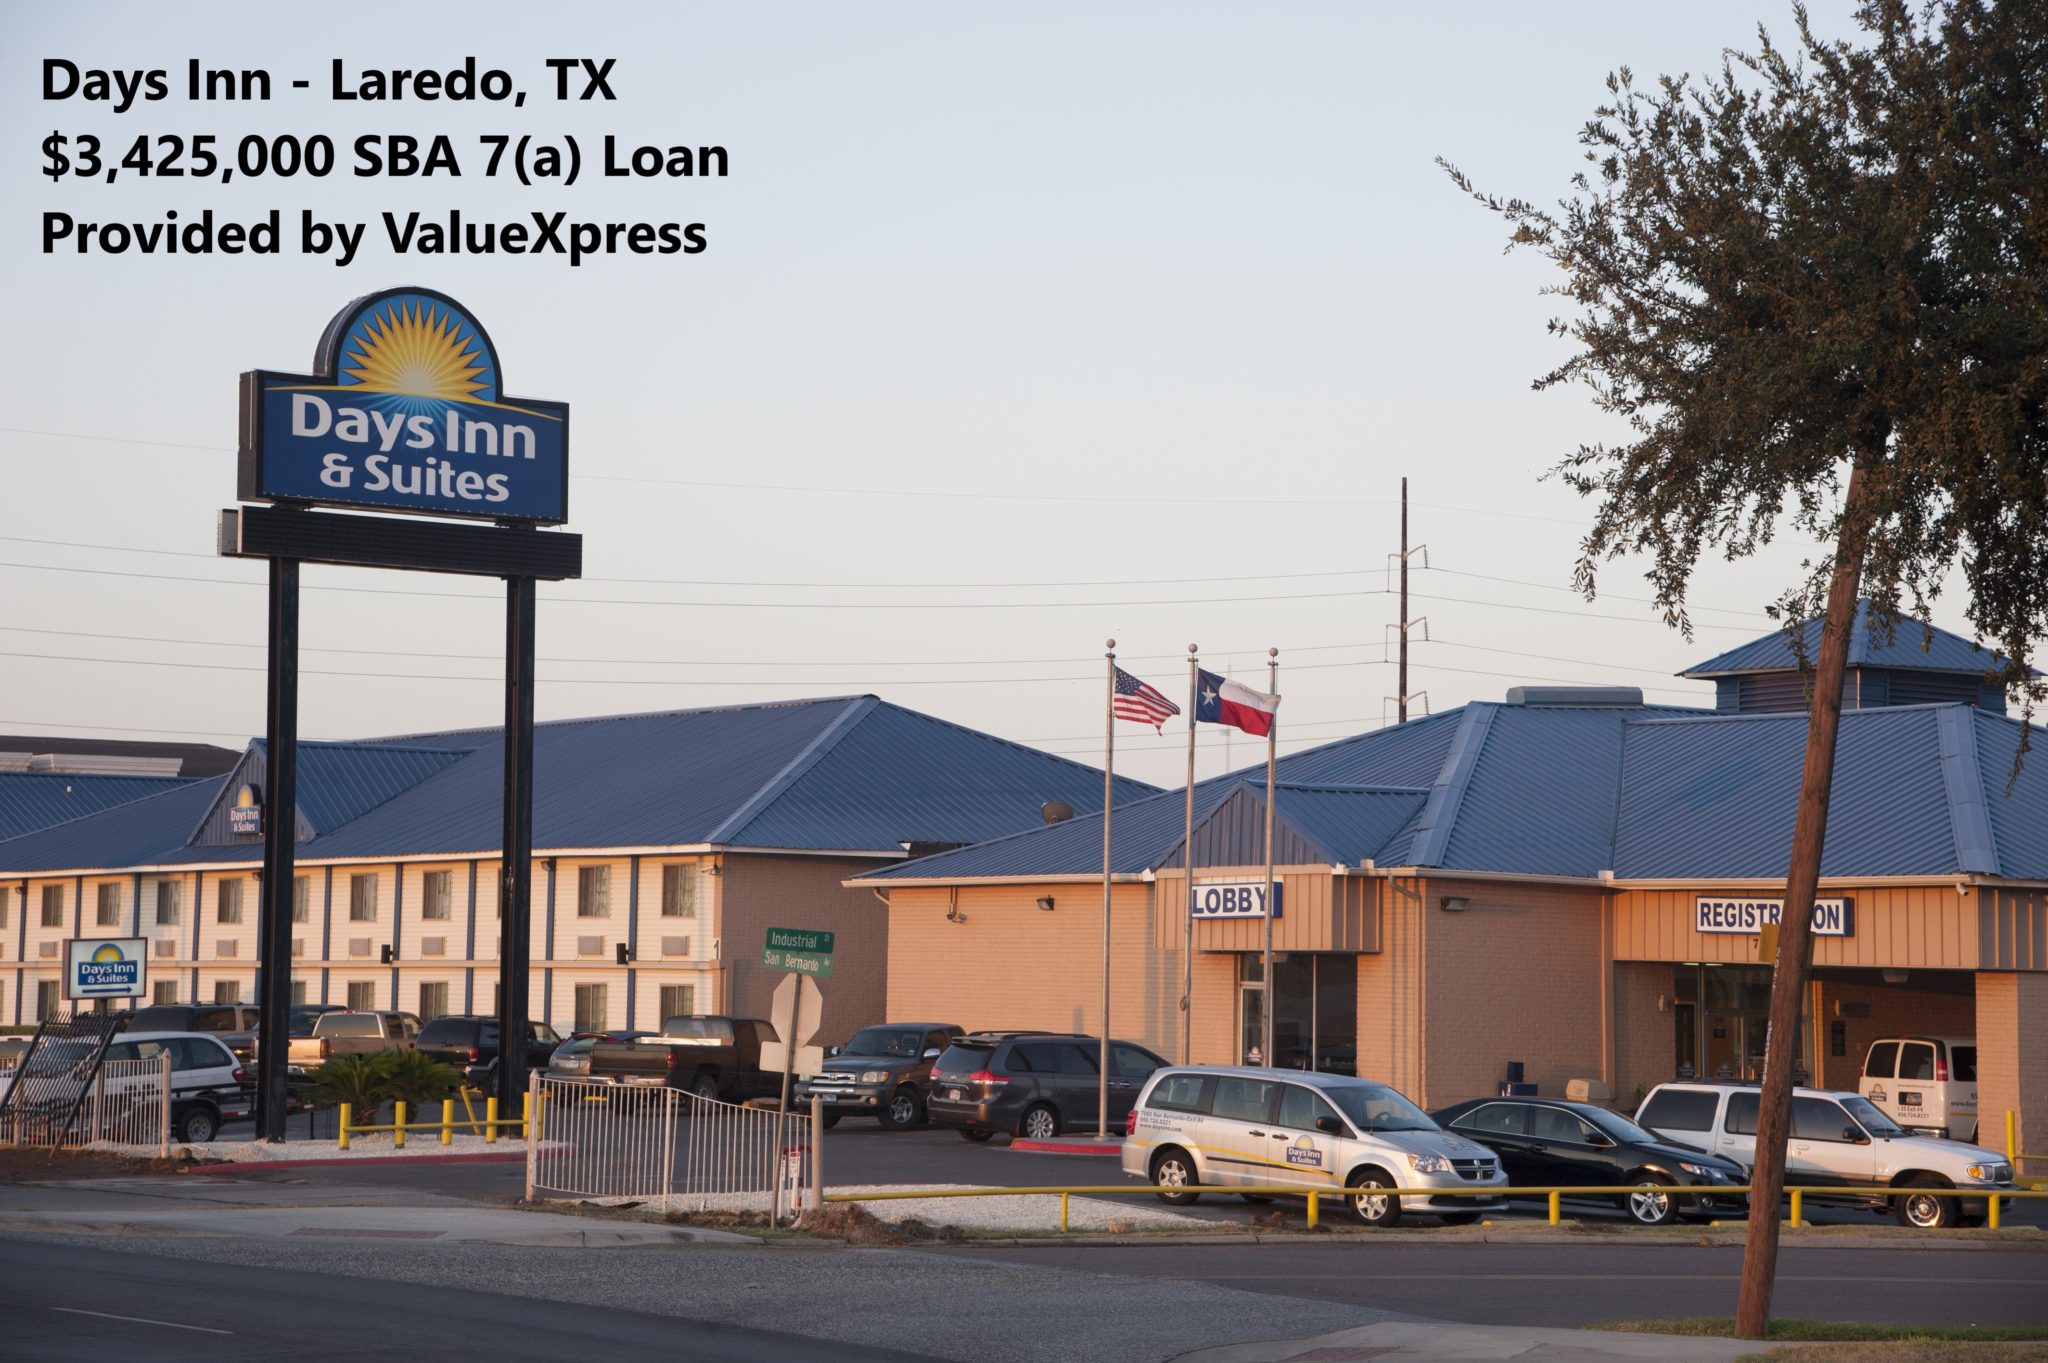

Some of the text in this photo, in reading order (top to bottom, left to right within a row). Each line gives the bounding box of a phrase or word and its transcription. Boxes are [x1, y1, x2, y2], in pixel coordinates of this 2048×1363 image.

[292, 393, 535, 459] Days Inn
[320, 453, 509, 502] & Suites
[231, 809, 259, 821] Days Inn
[238, 821, 255, 831] Suites
[1192, 886, 1266, 914] LOBBY
[1700, 902, 1840, 930] REGISTRON
[771, 931, 818, 949] Industrial
[81, 963, 135, 974] Days Inn
[764, 951, 780, 966] San
[785, 953, 819, 972] Bernardo
[87, 973, 129, 984] & Suites
[1288, 1147, 1320, 1159] Days Inn
[1297, 1156, 1317, 1165] Suites
